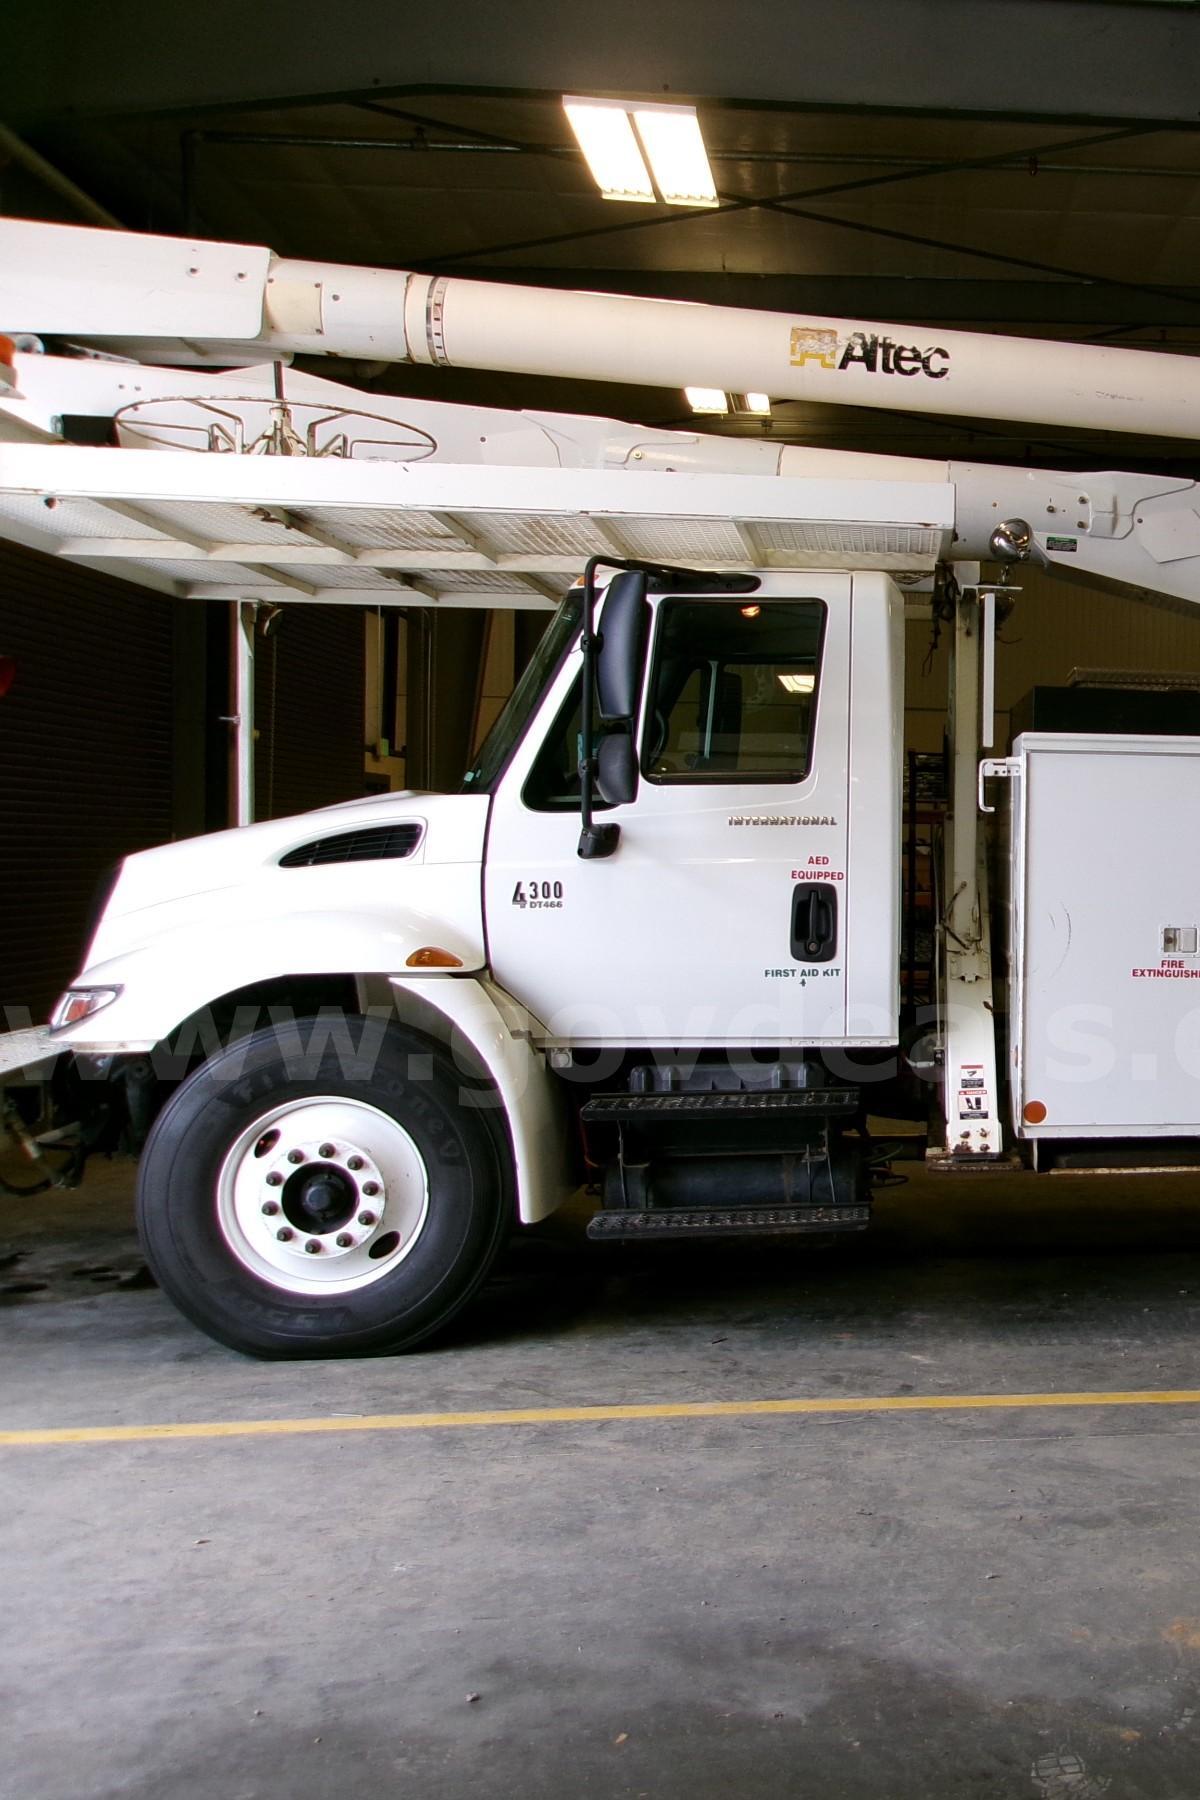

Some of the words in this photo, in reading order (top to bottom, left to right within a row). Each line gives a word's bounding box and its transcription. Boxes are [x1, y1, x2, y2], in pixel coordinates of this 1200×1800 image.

[838, 332, 950, 378] Altec
[728, 816, 837, 826] INTERNATIONAL
[808, 856, 829, 865] AED
[791, 870, 844, 880] EQUIPPED
[512, 881, 563, 908] 4300
[529, 901, 563, 909] DT466
[1161, 960, 1185, 968] FIRE
[764, 969, 797, 978] FIRST
[800, 969, 820, 977] AID
[822, 968, 841, 977] KIT
